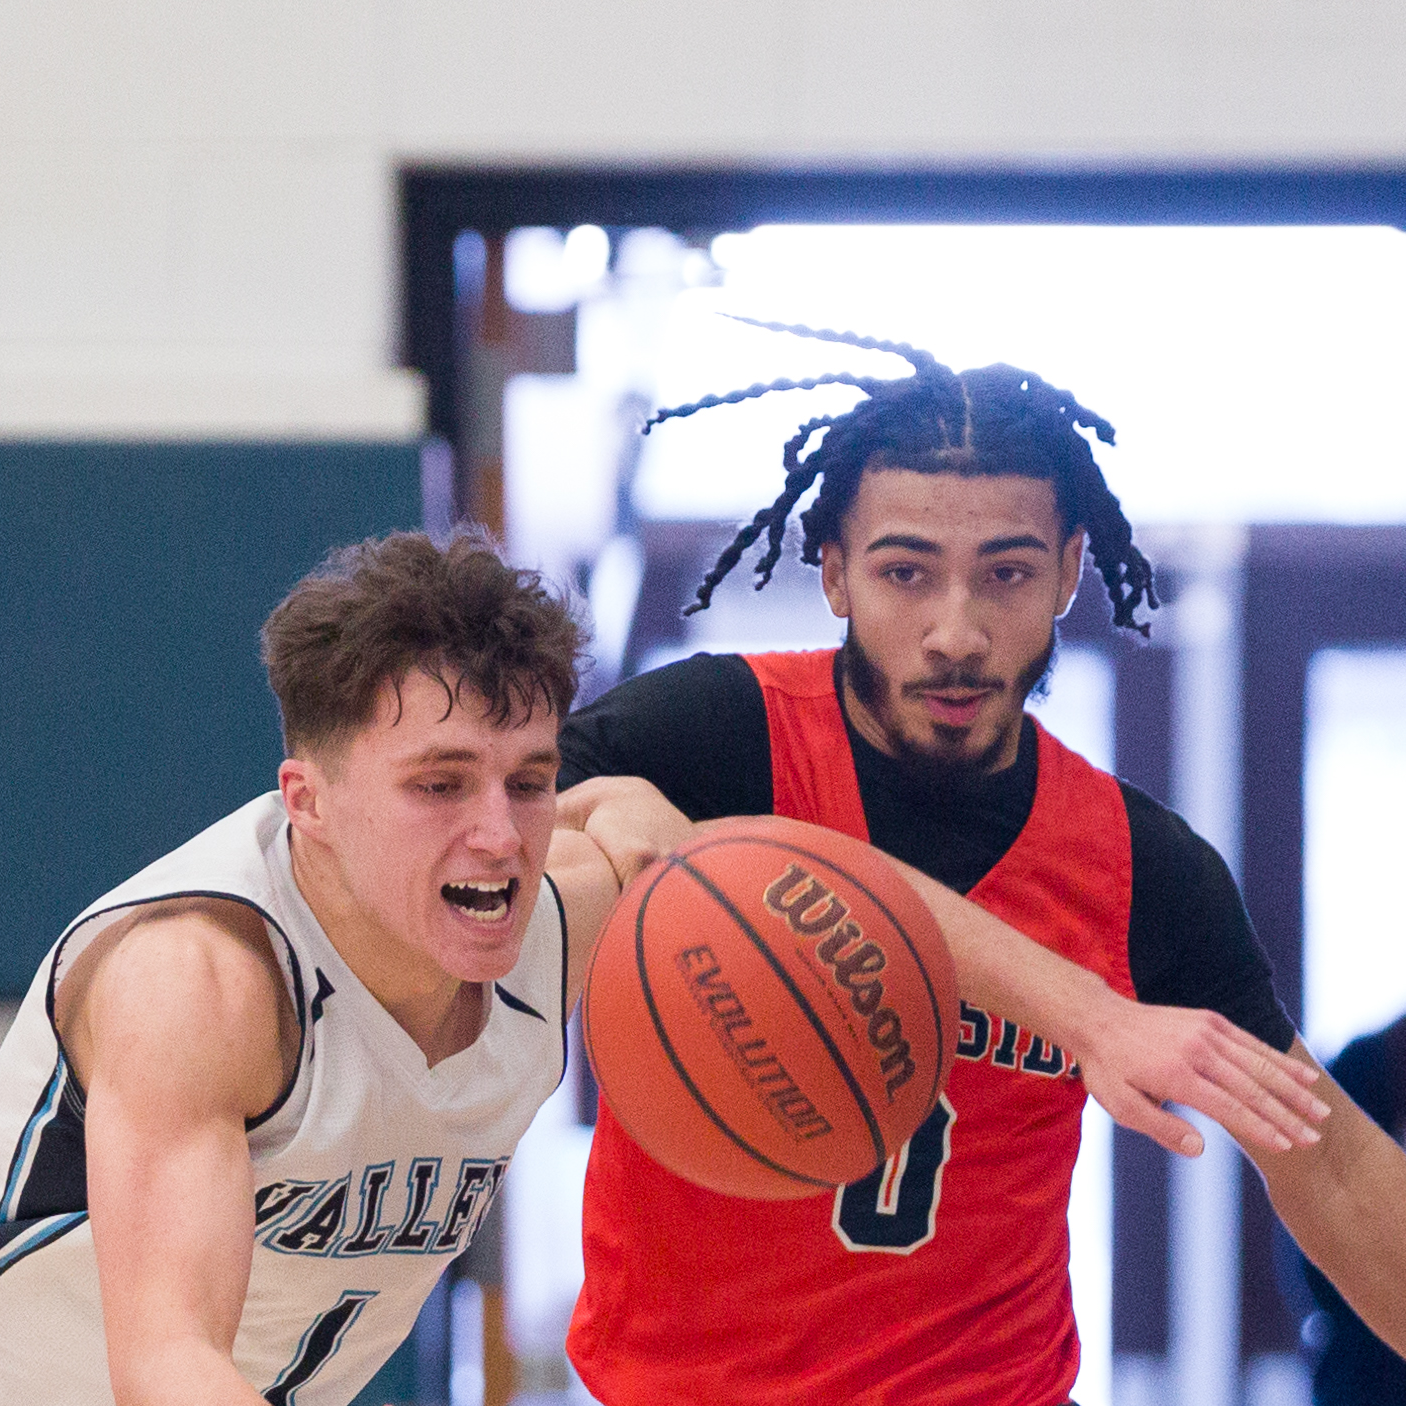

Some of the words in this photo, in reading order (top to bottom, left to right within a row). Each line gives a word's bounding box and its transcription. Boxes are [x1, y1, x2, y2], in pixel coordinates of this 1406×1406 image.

[673, 943, 834, 1142] EVOLUTION
[763, 861, 916, 1103] Wilson
[832, 1091, 958, 1256] 0
